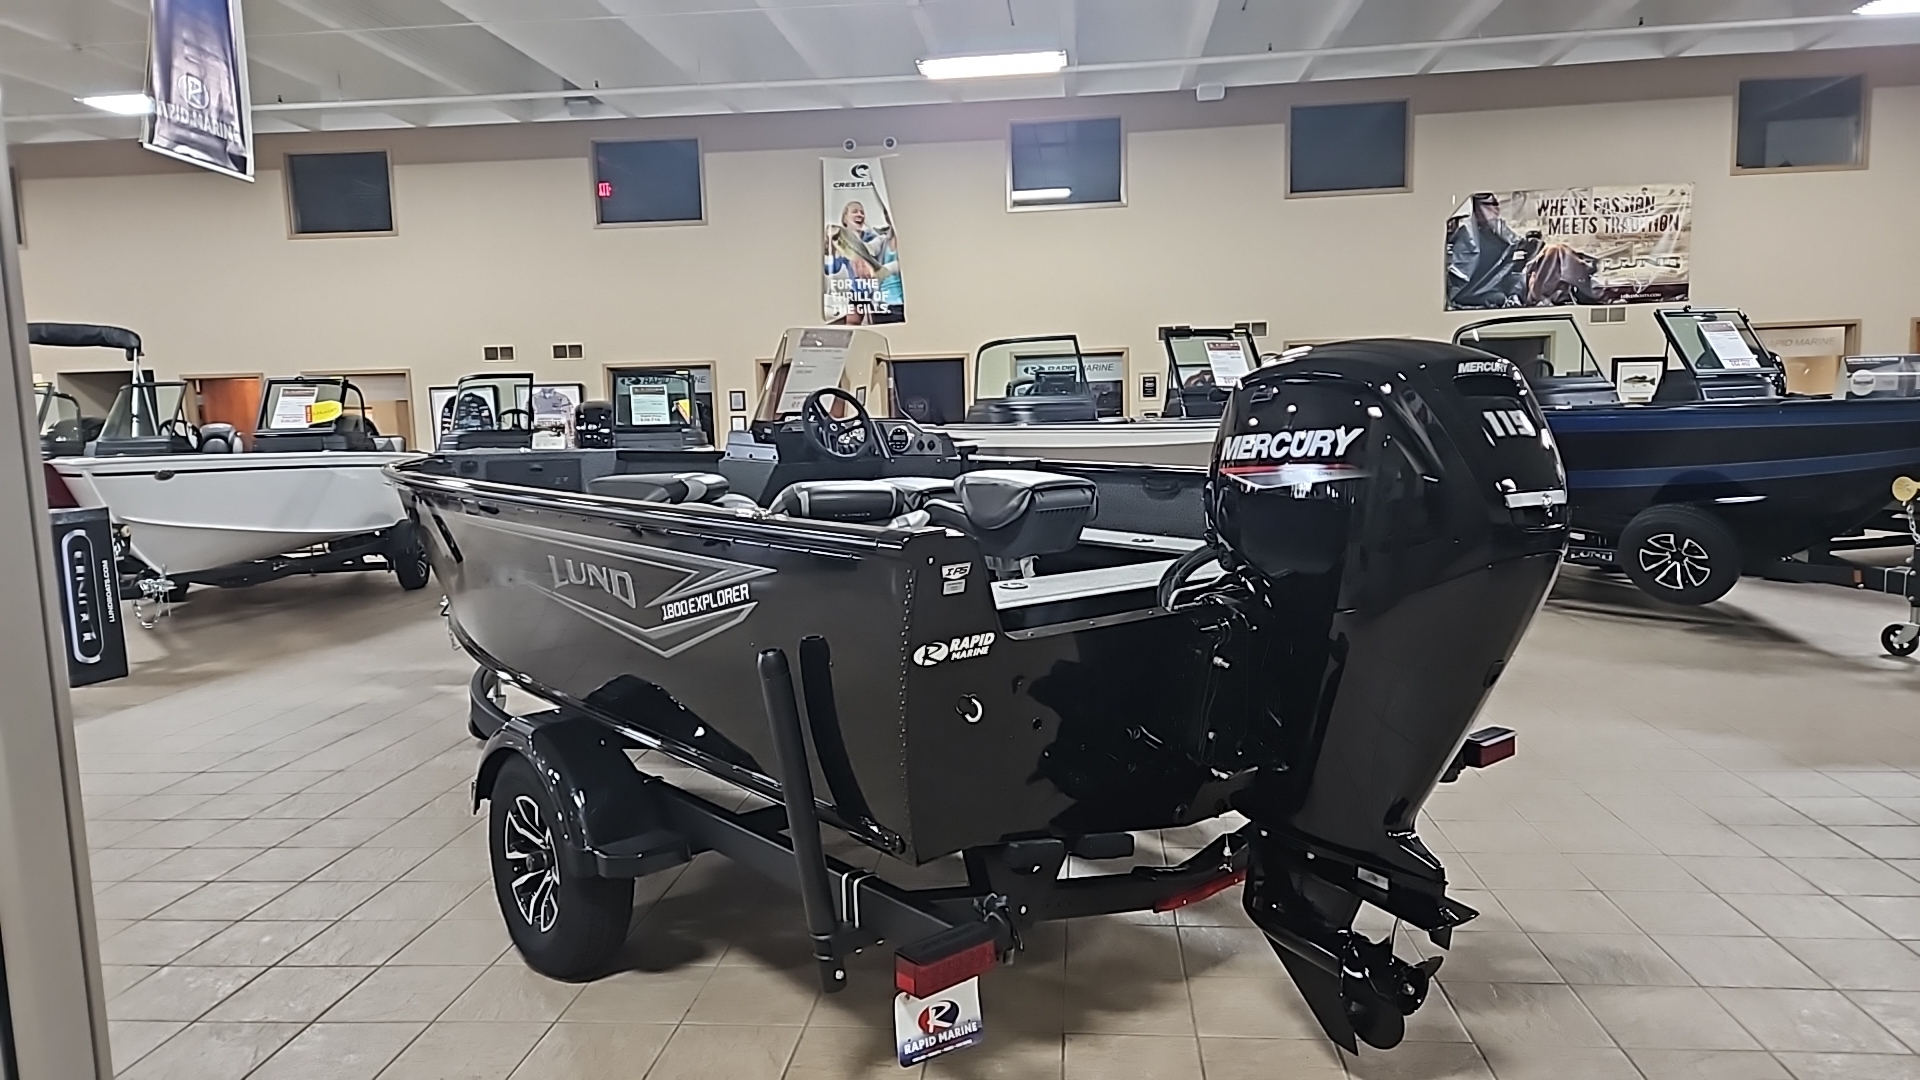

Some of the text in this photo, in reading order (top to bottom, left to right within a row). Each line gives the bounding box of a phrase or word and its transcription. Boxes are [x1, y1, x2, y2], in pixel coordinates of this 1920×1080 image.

[1537, 196, 1656, 216] WHERE PASSION
[1549, 217, 1597, 236] MEETS
[830, 278, 878, 290] FOR THE
[831, 291, 889, 302] THRILL OF
[832, 303, 891, 315] THE GILLS.
[1795, 336, 1836, 347] MARINE
[1458, 361, 1508, 374] MERCURY
[1220, 427, 1365, 461] MERCURY
[101, 559, 116, 623] LUNDBOATS.COM
[547, 554, 638, 609] LUND
[661, 583, 750, 622] 1800 EXPLORER
[949, 632, 996, 652] RAPID
[950, 645, 990, 661] MARINE
[904, 1036, 937, 1055] RAPID
[938, 1022, 978, 1043] MARINE
